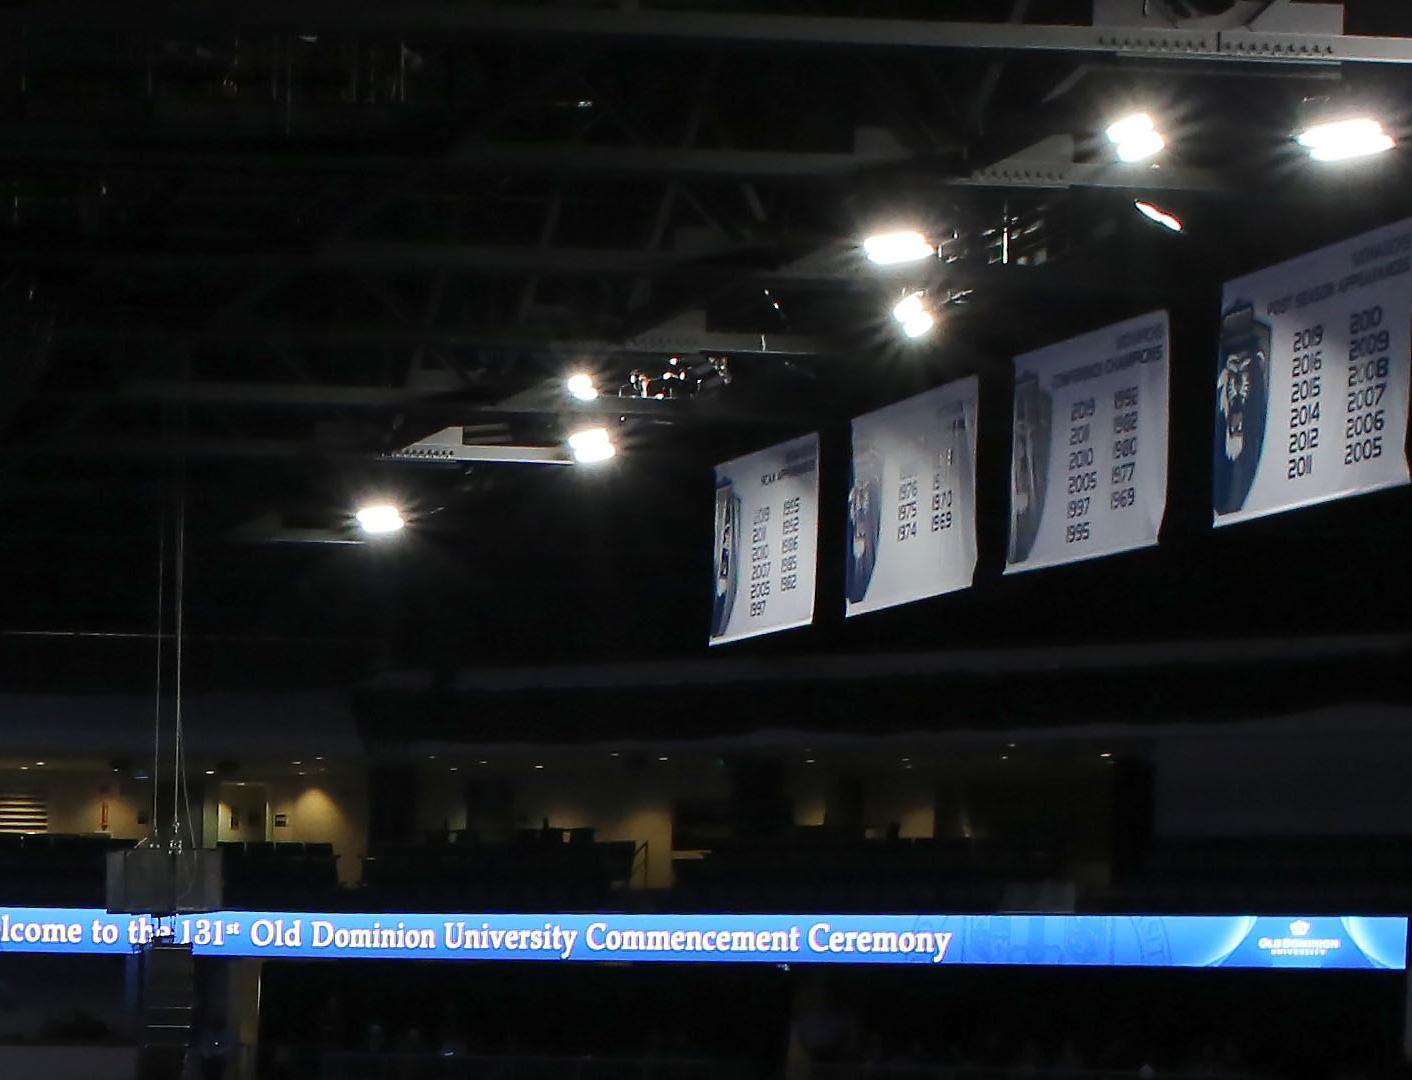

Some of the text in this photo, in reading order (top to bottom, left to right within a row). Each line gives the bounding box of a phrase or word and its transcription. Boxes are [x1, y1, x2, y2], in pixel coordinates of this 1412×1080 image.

[1350, 305, 1382, 335] 2010
[1293, 325, 1323, 353] 2019
[1349, 330, 1389, 361] 2009
[1292, 351, 1322, 377] 2016
[1348, 356, 1389, 387] 2008
[1291, 376, 1321, 403] 2015
[1347, 383, 1387, 413] 2007
[1290, 401, 1320, 428] 2014
[1346, 410, 1385, 439] 2006
[1070, 424, 1090, 446] 2011
[1289, 428, 1319, 453] 2012
[1069, 448, 1094, 470] 2010
[1345, 437, 1382, 465] 2005
[1111, 462, 1135, 485] 1977
[1288, 454, 1312, 480] 2011
[1068, 471, 1097, 495] 2005
[1067, 497, 1090, 519] 1997
[1110, 487, 1135, 510] 1969
[1066, 522, 1090, 544] 1995
[91, 918, 119, 944] to
[181, 919, 240, 946] 131st
[251, 919, 302, 947] Old
[311, 920, 436, 950] Dominion
[444, 922, 578, 959] University
[585, 923, 800, 954] Commencement
[807, 924, 952, 963] Ceremony
